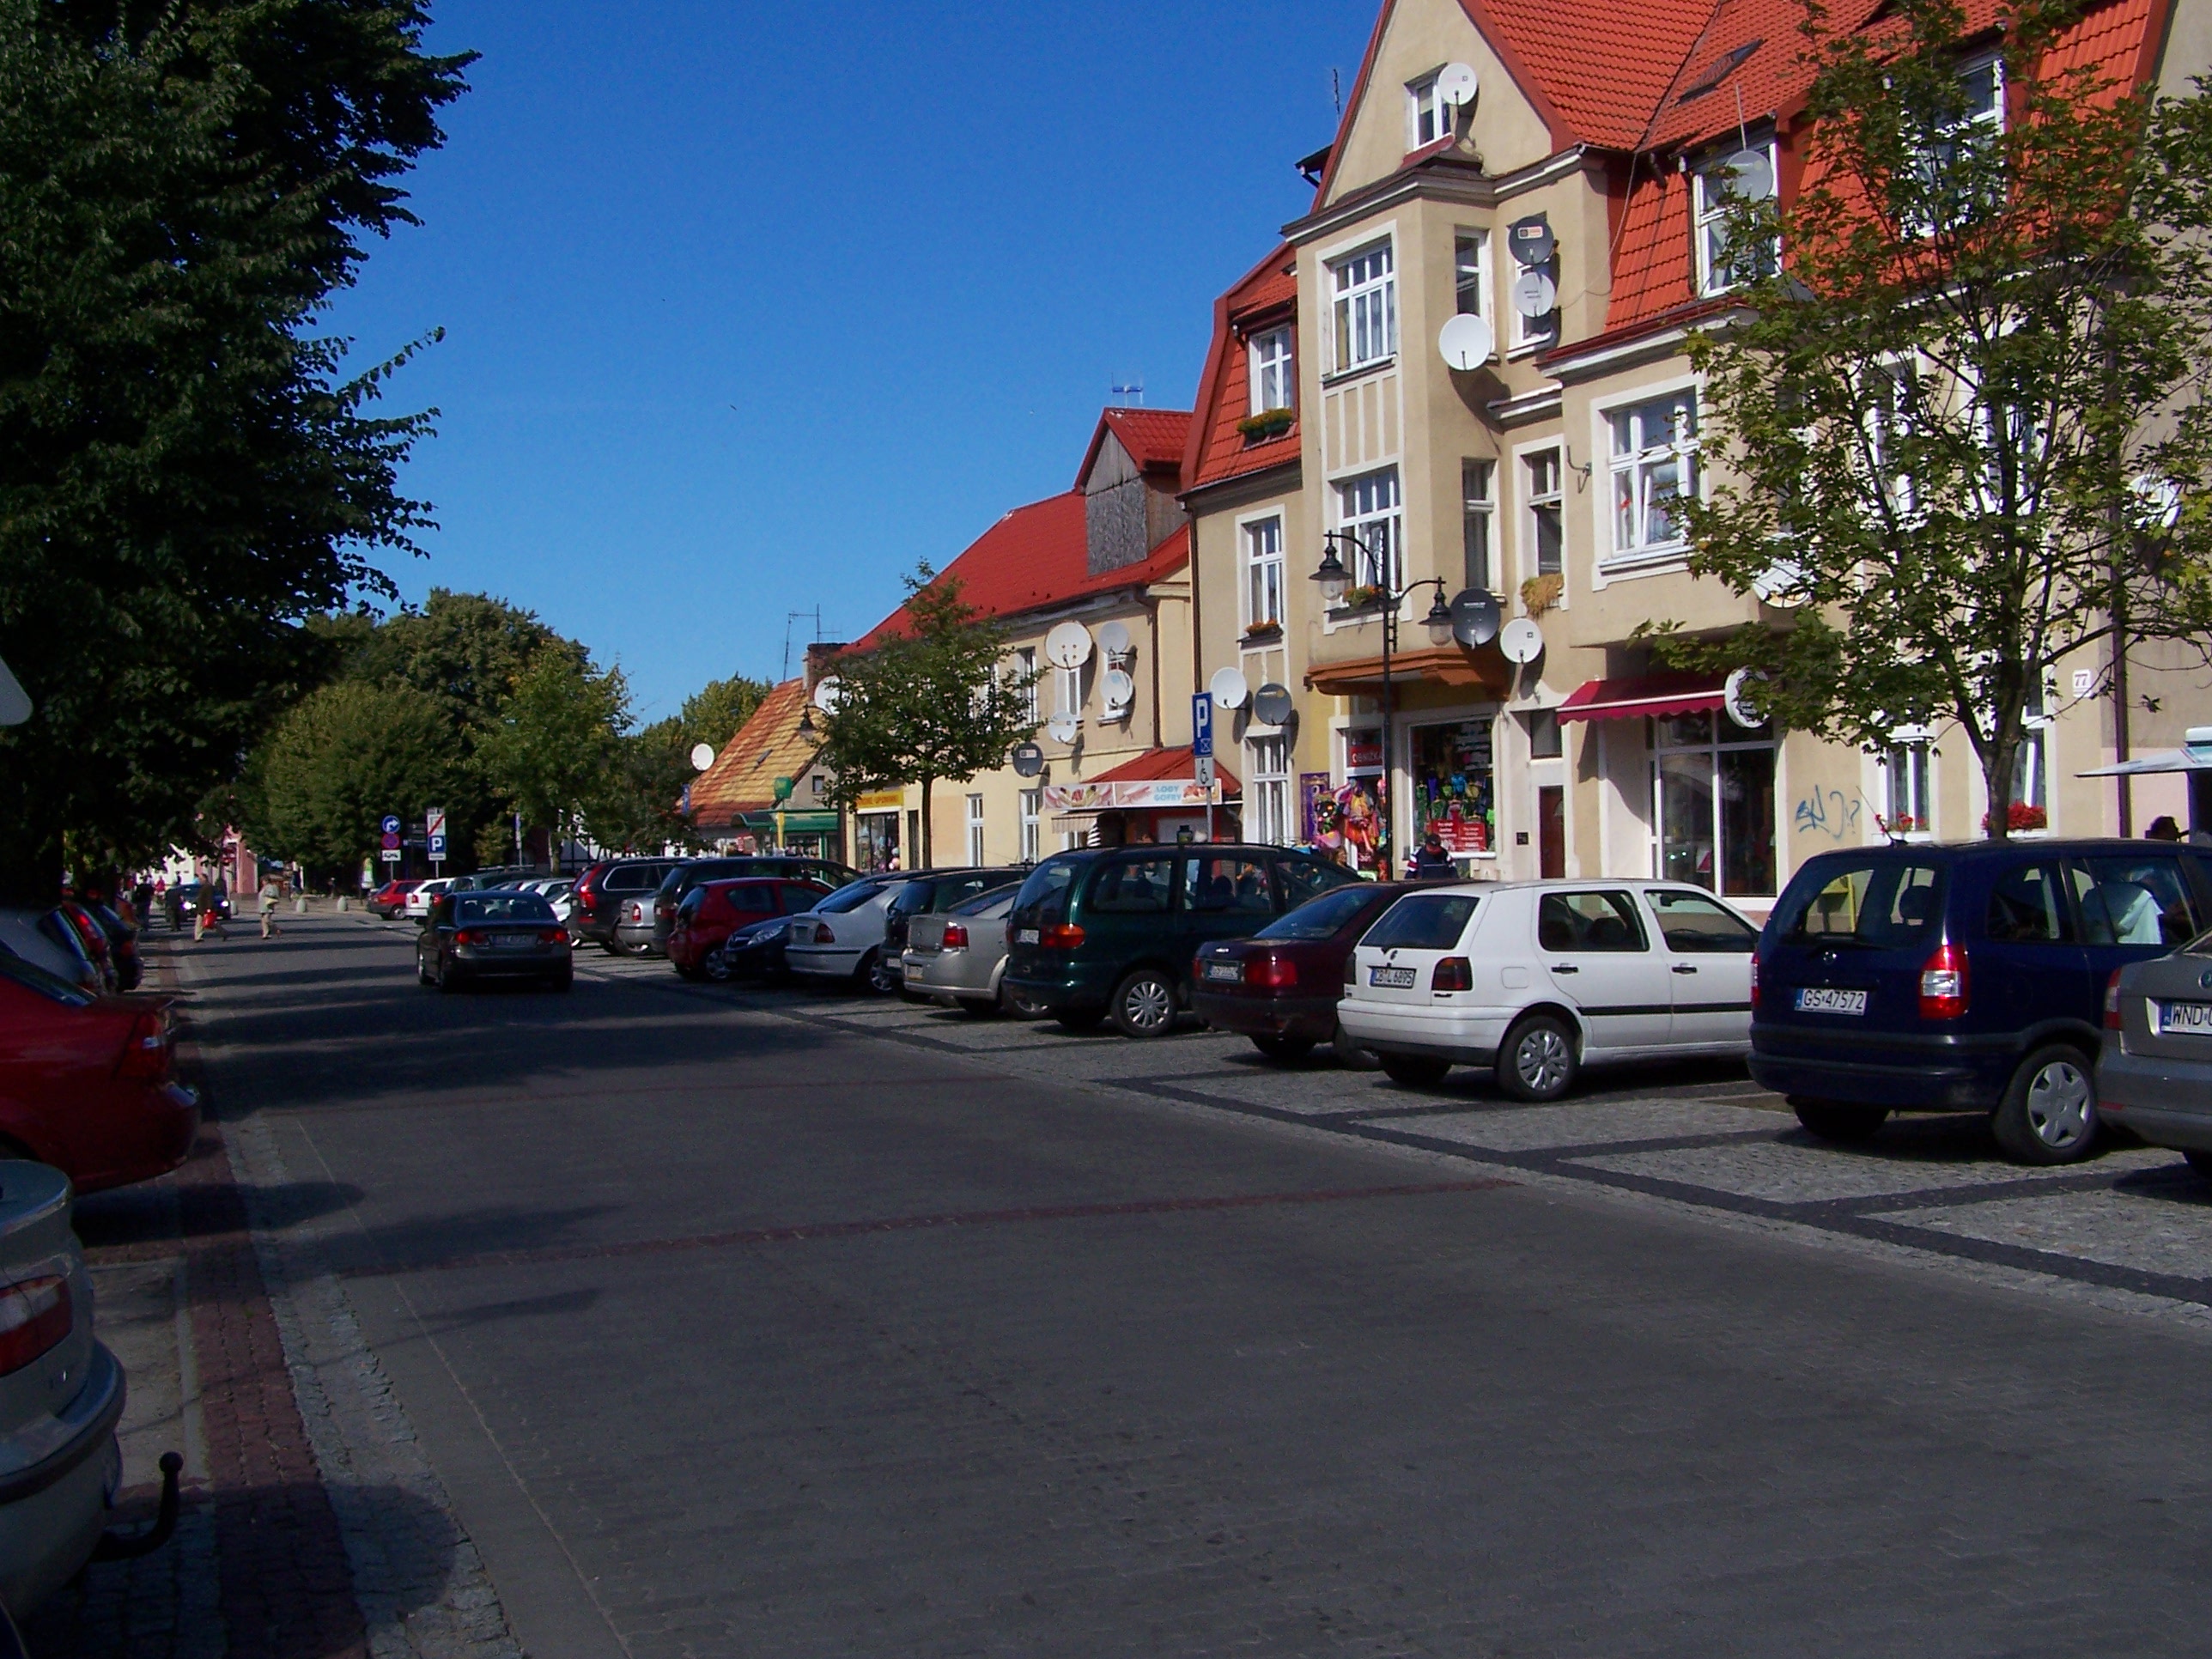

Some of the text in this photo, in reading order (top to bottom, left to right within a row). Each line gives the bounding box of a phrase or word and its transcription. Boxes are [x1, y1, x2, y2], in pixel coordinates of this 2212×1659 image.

[2074, 673, 2088, 687] 77
[1196, 698, 1209, 738] P
[432, 837, 442, 851] P
[1826, 991, 1863, 1009] 47572
